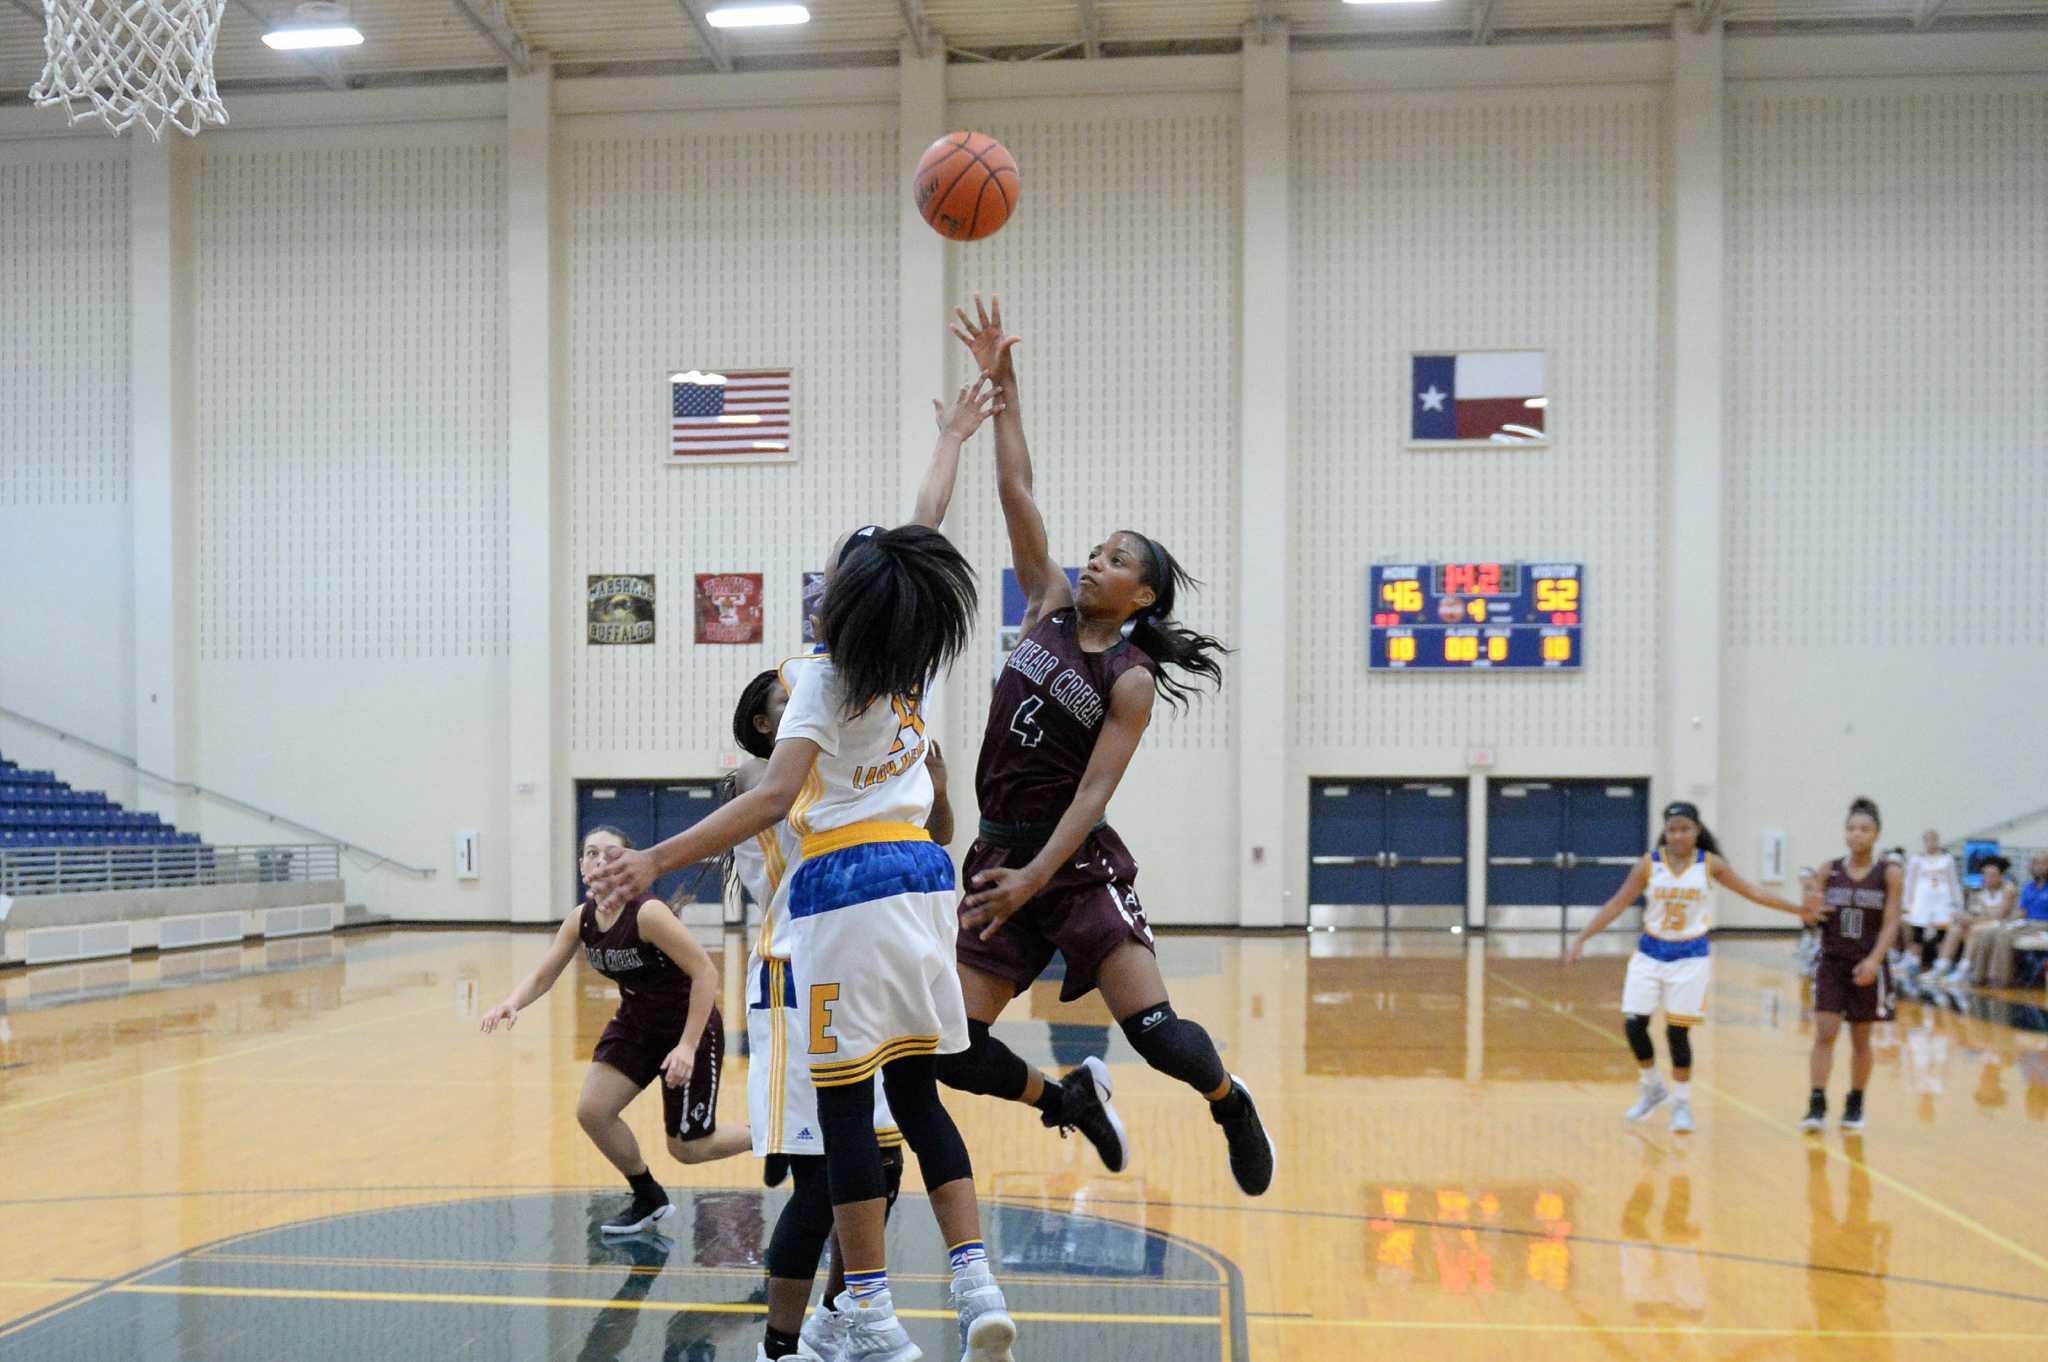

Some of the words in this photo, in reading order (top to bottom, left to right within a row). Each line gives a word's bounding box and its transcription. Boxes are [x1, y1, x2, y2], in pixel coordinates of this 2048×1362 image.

[1382, 580, 1423, 612] 46
[1536, 579, 1579, 611] 52
[1009, 694, 1044, 747] 4
[1049, 668, 1105, 729] CREEK
[808, 982, 840, 1054] E
